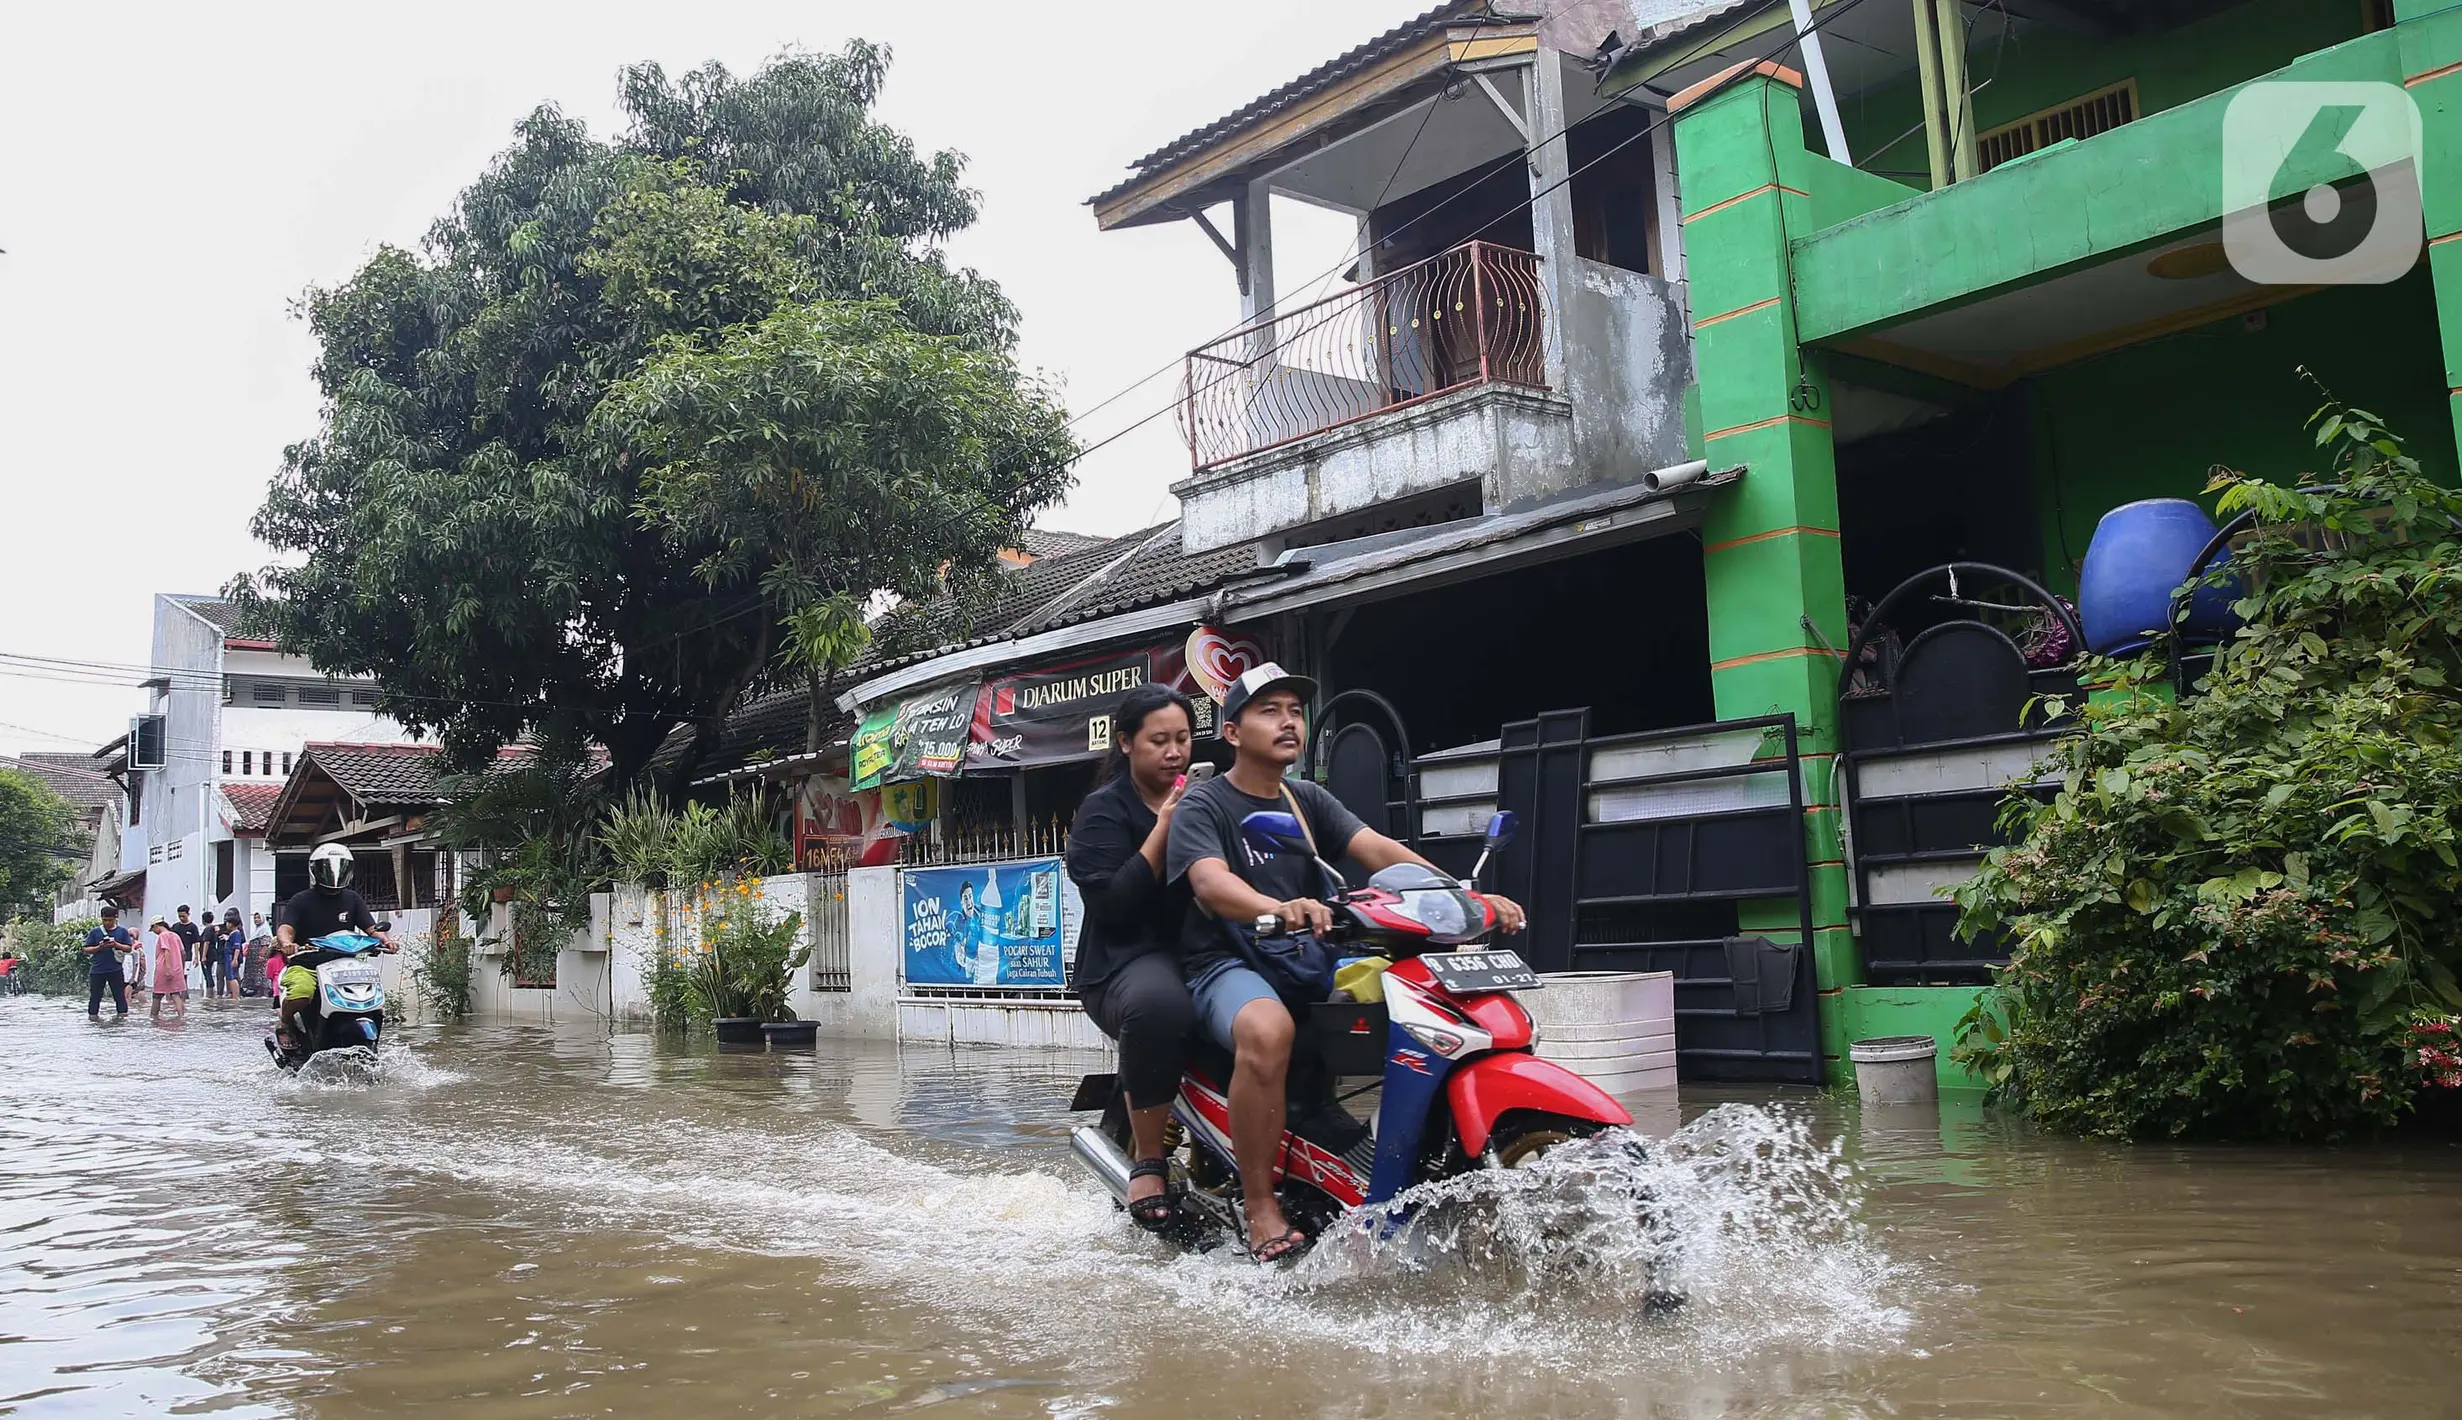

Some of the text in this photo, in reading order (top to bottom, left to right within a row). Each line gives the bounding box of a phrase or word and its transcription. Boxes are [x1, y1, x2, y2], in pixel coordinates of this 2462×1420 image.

[1022, 665, 1142, 710] DJARUM SUPER
[920, 717, 947, 735] TEH
[948, 713, 965, 731] LO
[1092, 719, 1107, 740] 12
[990, 734, 1023, 757] SUPER
[806, 848, 819, 868] 16
[912, 896, 940, 920] ION
[908, 909, 947, 938] TAHAN
[913, 930, 947, 953] BOCOR
[1003, 944, 1056, 956] POCARI SWEAT
[1022, 957, 1050, 968] SAHUR
[1427, 953, 1521, 973] B 6356 CHD
